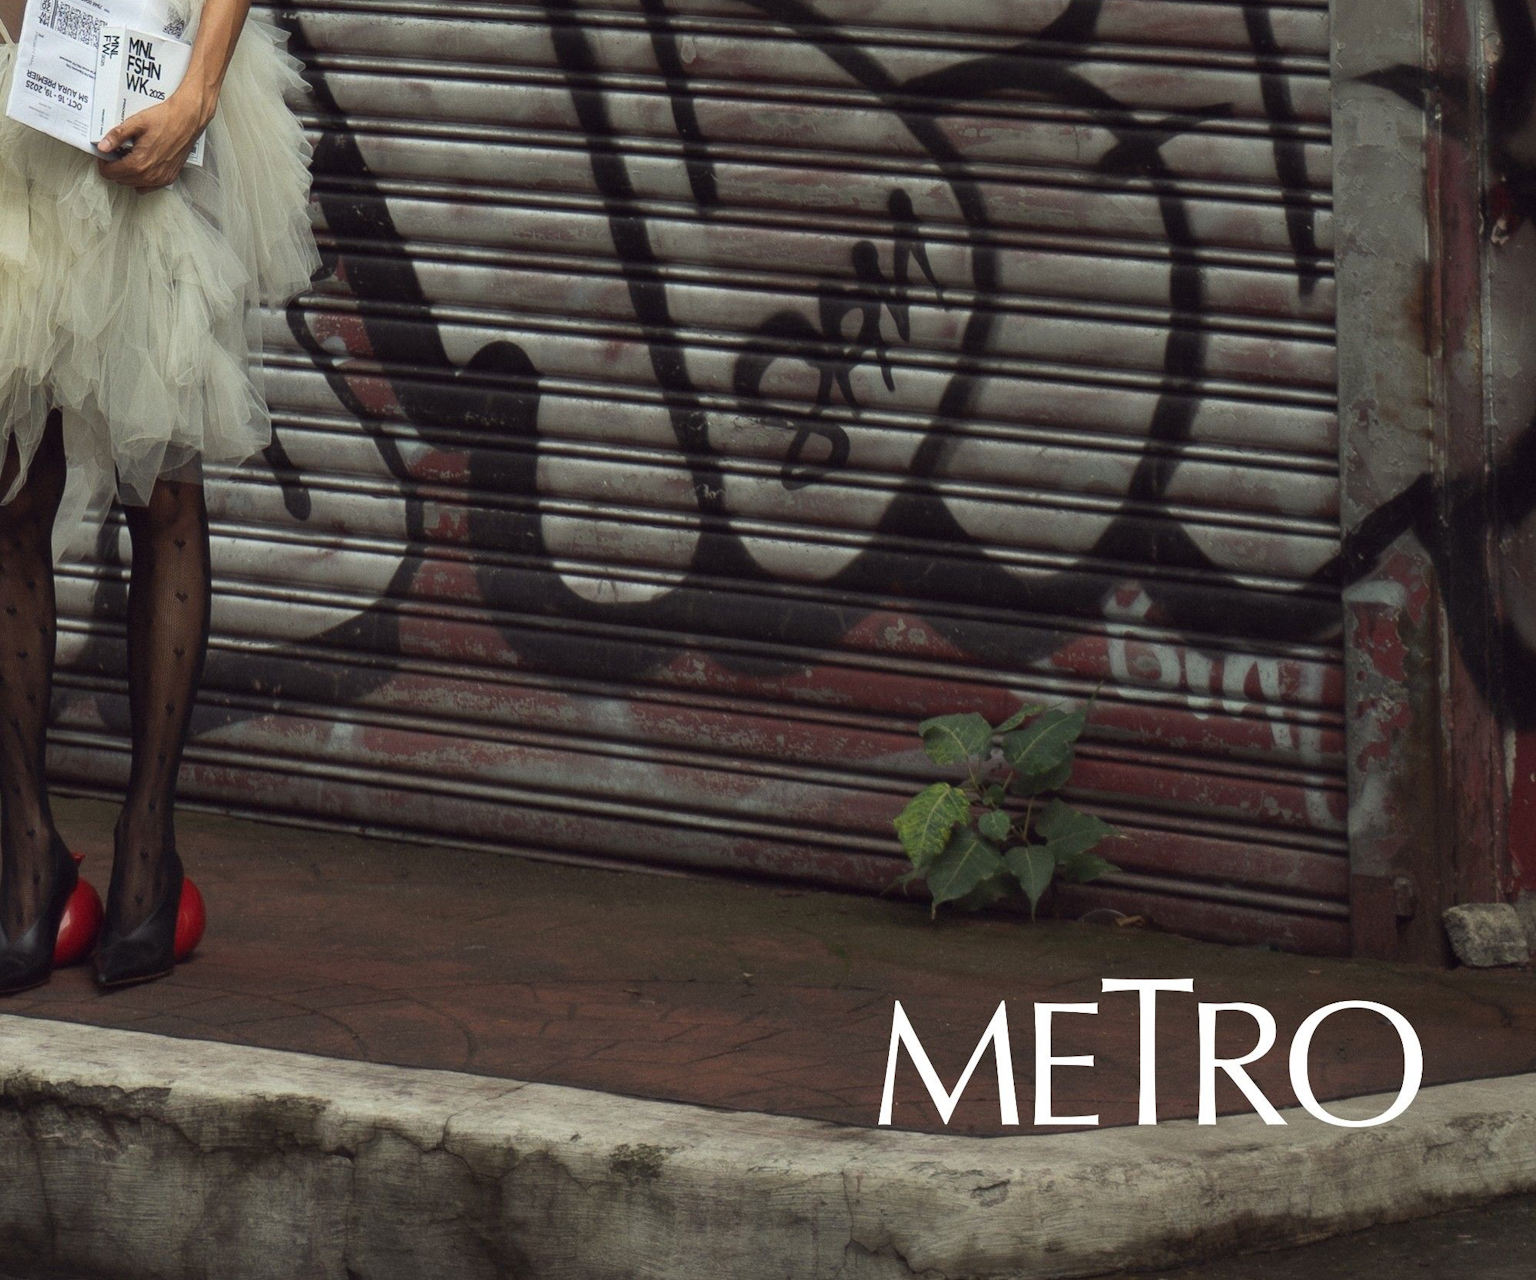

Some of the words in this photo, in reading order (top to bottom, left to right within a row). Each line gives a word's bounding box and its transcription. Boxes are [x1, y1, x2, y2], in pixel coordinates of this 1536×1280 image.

[102, 35, 111, 55] FW
[110, 36, 120, 59] MNL
[129, 36, 155, 61] MNL
[127, 54, 162, 81] FSHN
[25, 79, 43, 94] 2025
[26, 69, 57, 89] PREMIER
[126, 72, 148, 96] WK
[149, 89, 165, 101] 2025
[57, 83, 77, 98] AURA
[78, 92, 89, 104] SM
